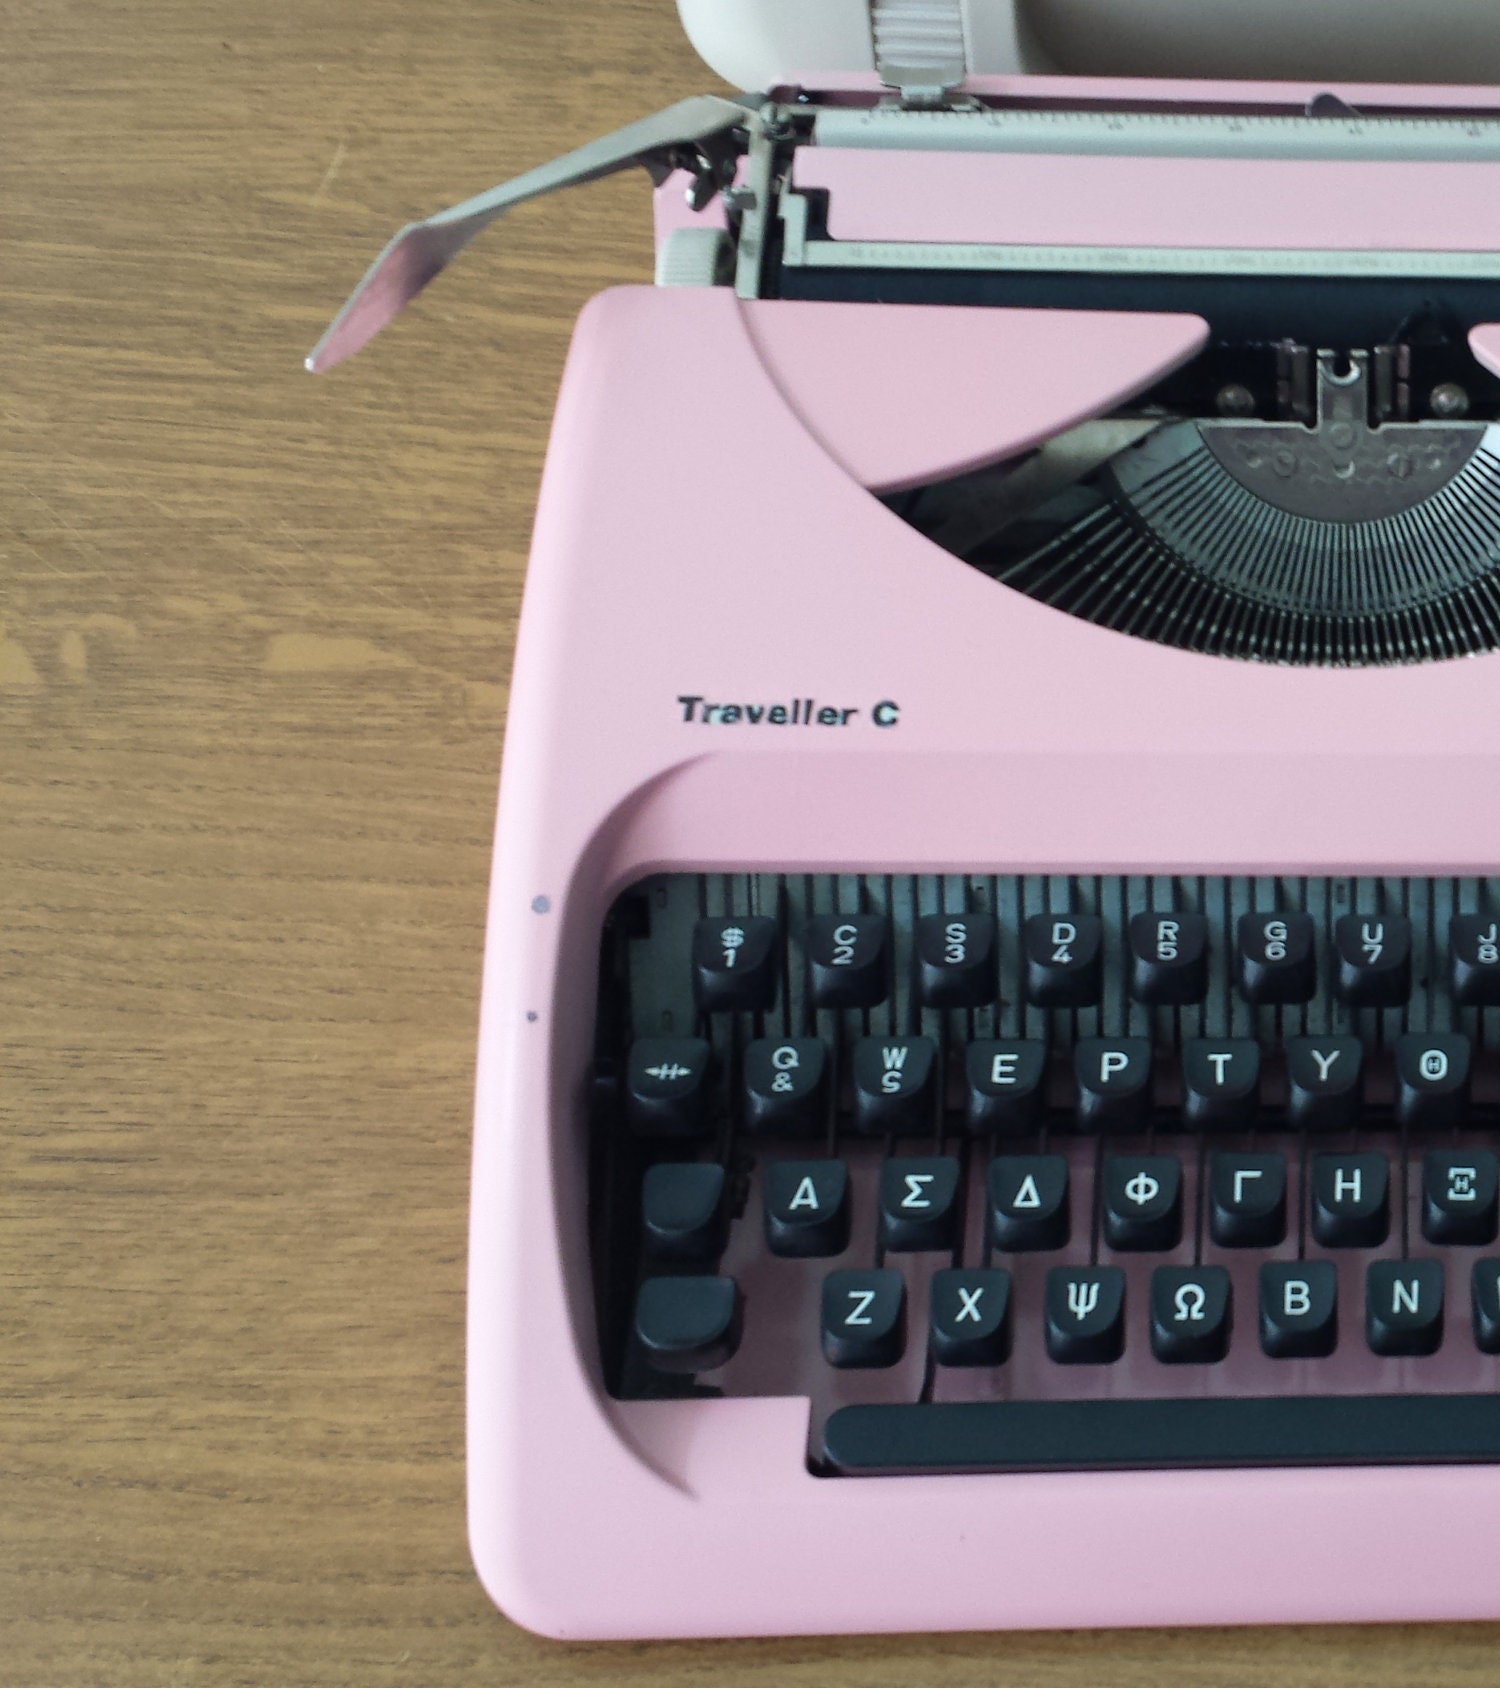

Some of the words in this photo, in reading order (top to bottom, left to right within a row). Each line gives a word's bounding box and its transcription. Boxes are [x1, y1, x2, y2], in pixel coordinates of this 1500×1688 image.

[677, 695, 859, 726] Traveller
[871, 699, 900, 728] C
[721, 927, 745, 948] $
[832, 924, 859, 946] C
[944, 922, 968, 944] S
[1051, 922, 1077, 945] D
[1156, 920, 1180, 943] R
[1263, 921, 1288, 943] G
[1361, 923, 1384, 943] U
[1477, 923, 1498, 943] J
[722, 948, 737, 967] 1
[831, 945, 855, 965] 2
[944, 943, 966, 963] 3
[1051, 944, 1074, 963] 4
[1156, 941, 1179, 960] 5
[1264, 941, 1287, 960] 6
[1361, 942, 1384, 963] 7
[1477, 942, 1500, 963] 8
[771, 1046, 800, 1070] Q
[881, 1047, 908, 1070] W
